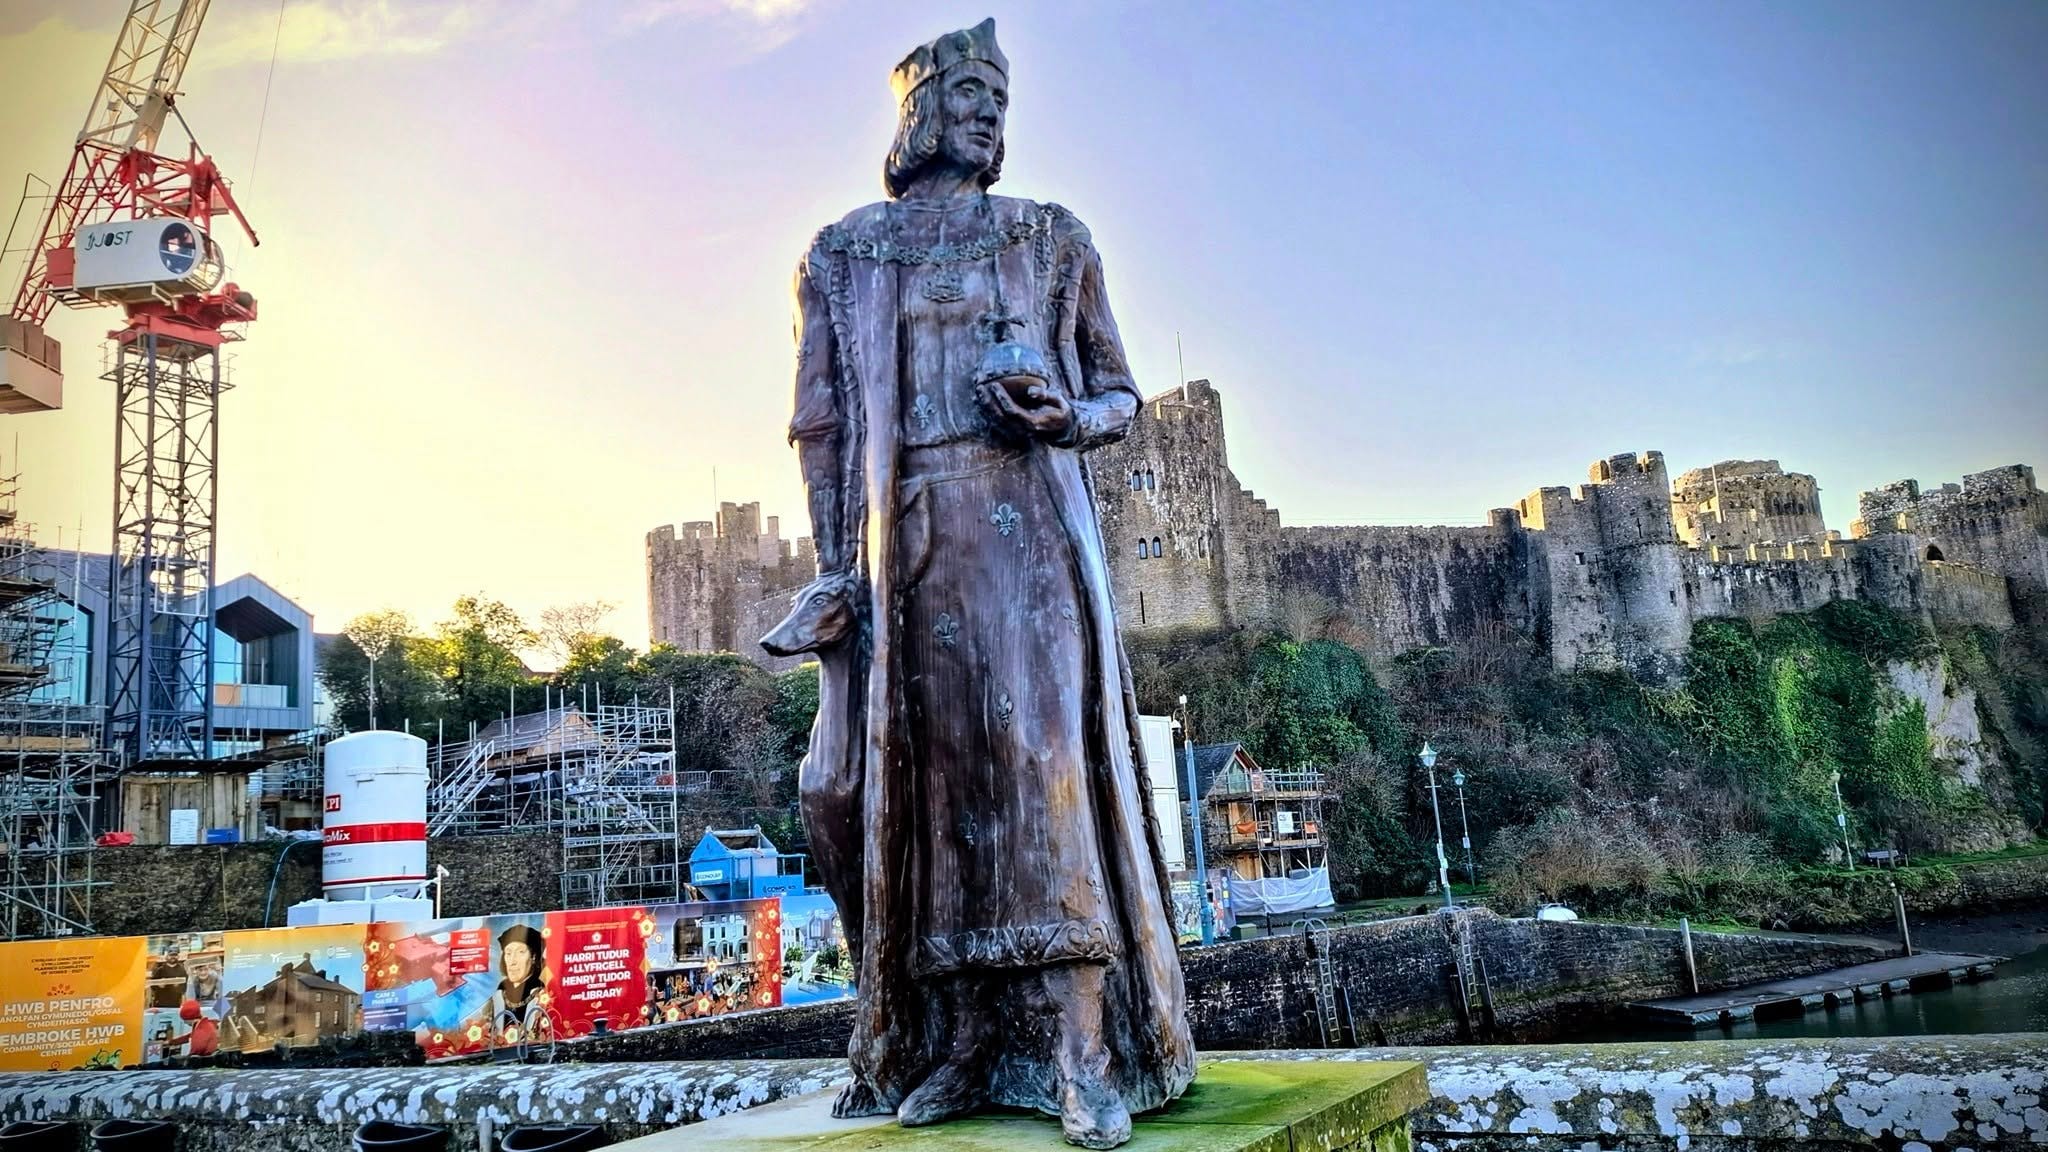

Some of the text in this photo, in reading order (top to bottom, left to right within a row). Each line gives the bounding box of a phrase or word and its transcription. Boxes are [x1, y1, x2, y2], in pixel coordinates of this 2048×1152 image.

[94, 231, 133, 248] JOST
[564, 949, 629, 963] HARRI TUDUR
[574, 960, 626, 973] LLYFRGELL
[562, 971, 631, 986] HENRY TUDOR
[582, 987, 622, 1001] LIBRARY
[4, 997, 114, 1016] HWB PENFRO
[0, 1013, 40, 1024] ANOLFAN
[0, 1024, 125, 1046] EMBROKE HWB
[87, 1037, 110, 1046] CARE
[40, 1048, 72, 1057] CENTRE
